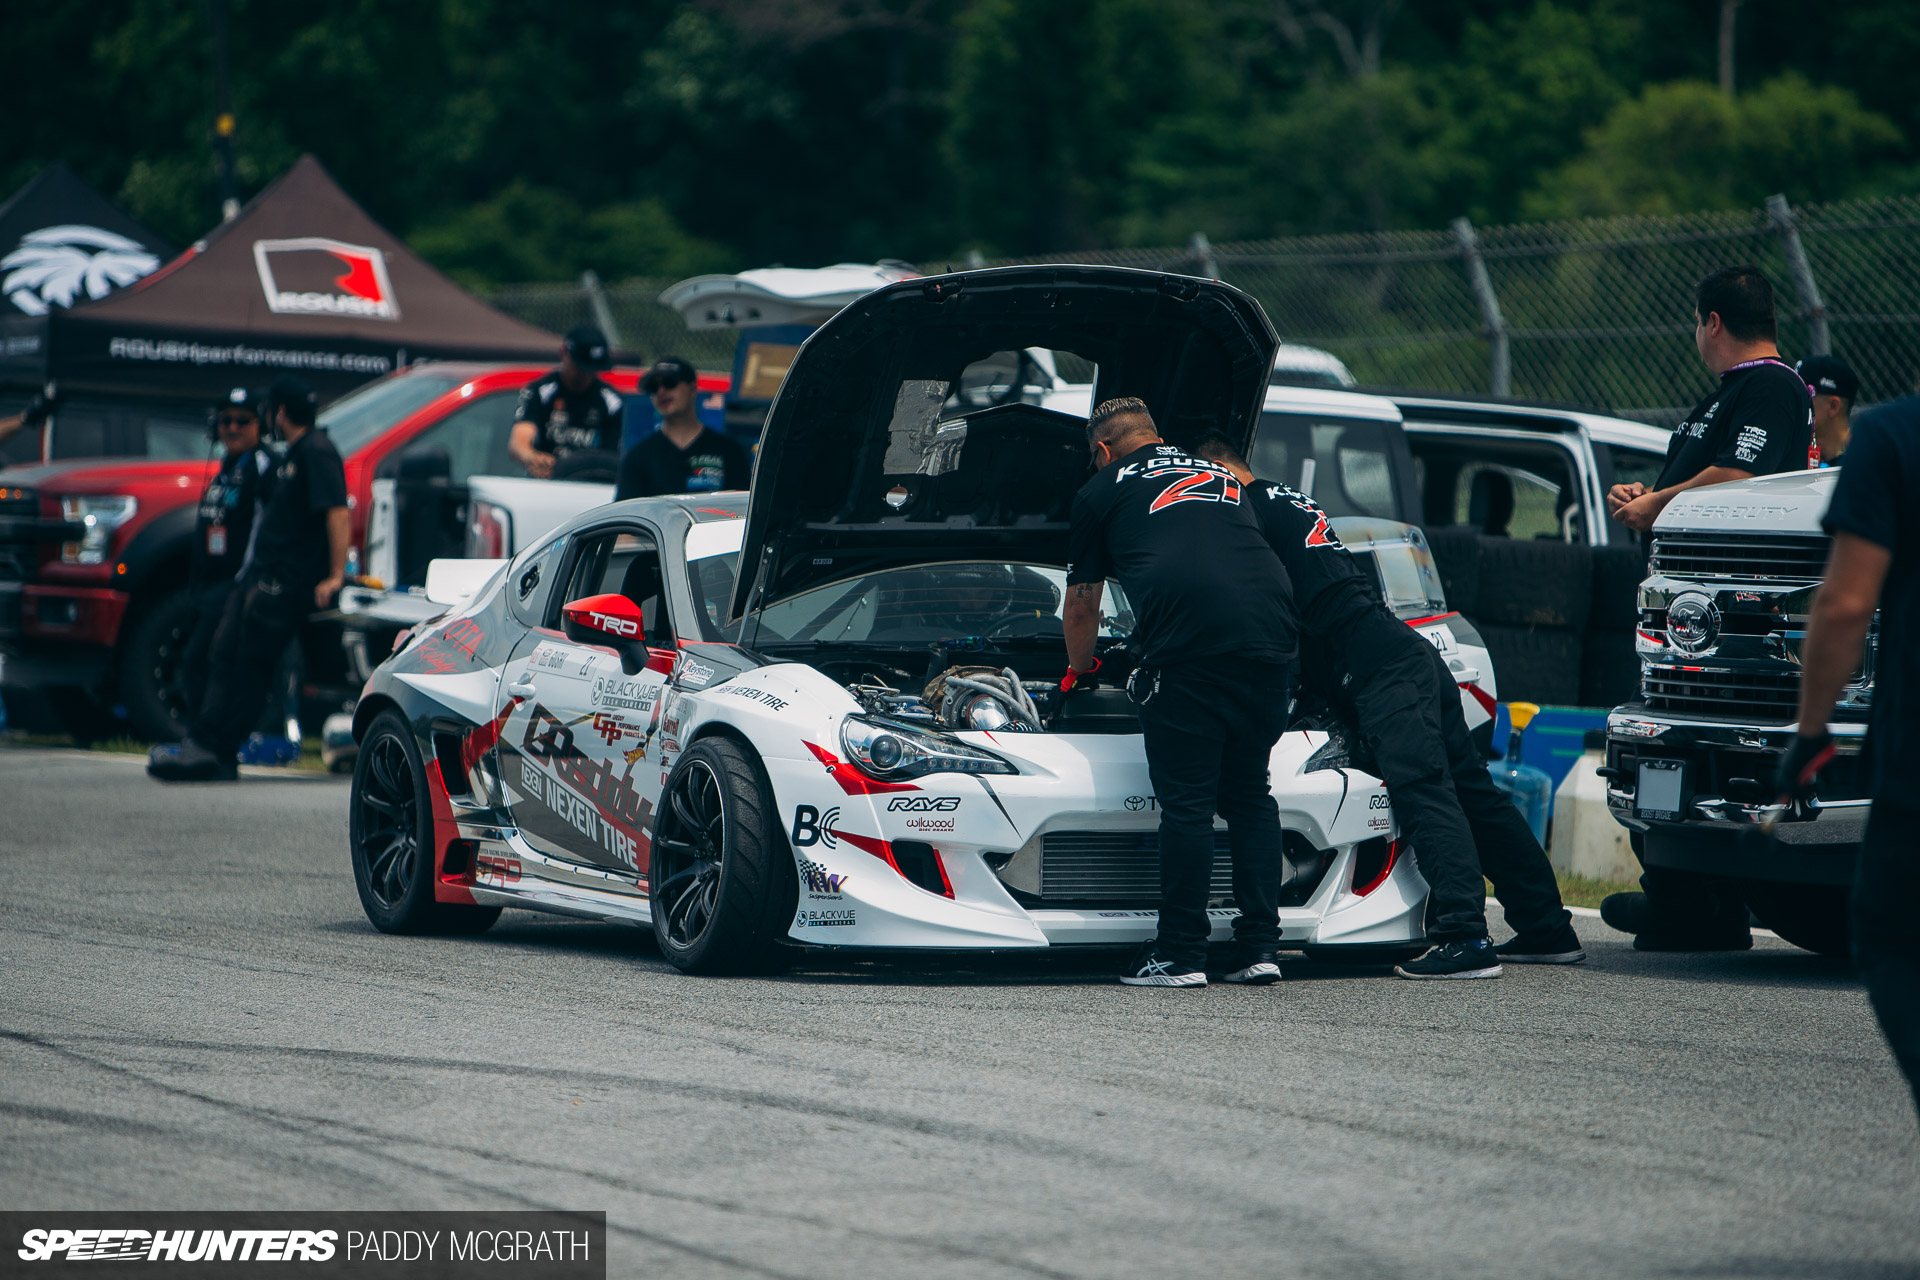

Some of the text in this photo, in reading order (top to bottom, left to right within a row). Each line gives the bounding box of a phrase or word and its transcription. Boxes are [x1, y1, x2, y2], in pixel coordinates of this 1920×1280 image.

[110, 337, 390, 373] ROUSHperformance.com
[1744, 425, 1767, 437] TRD
[1142, 467, 1241, 515] 21
[1668, 504, 1798, 520] SUPER DUTY
[590, 611, 637, 635] TRD
[1431, 632, 1448, 651] 21
[579, 655, 597, 676] 21
[605, 680, 658, 700] BLACKVUE
[728, 686, 765, 700] NEXEN
[759, 693, 789, 711] TIRE
[621, 699, 651, 711] CAMERAS
[887, 797, 961, 811] RAYS
[1369, 795, 1392, 809] RAY
[546, 777, 597, 842] NEXEN
[601, 816, 639, 871] TIRE
[906, 816, 954, 828] wilwood
[478, 855, 522, 888] TRD
[807, 871, 849, 894] KW
[809, 910, 856, 920] BLACKVUE
